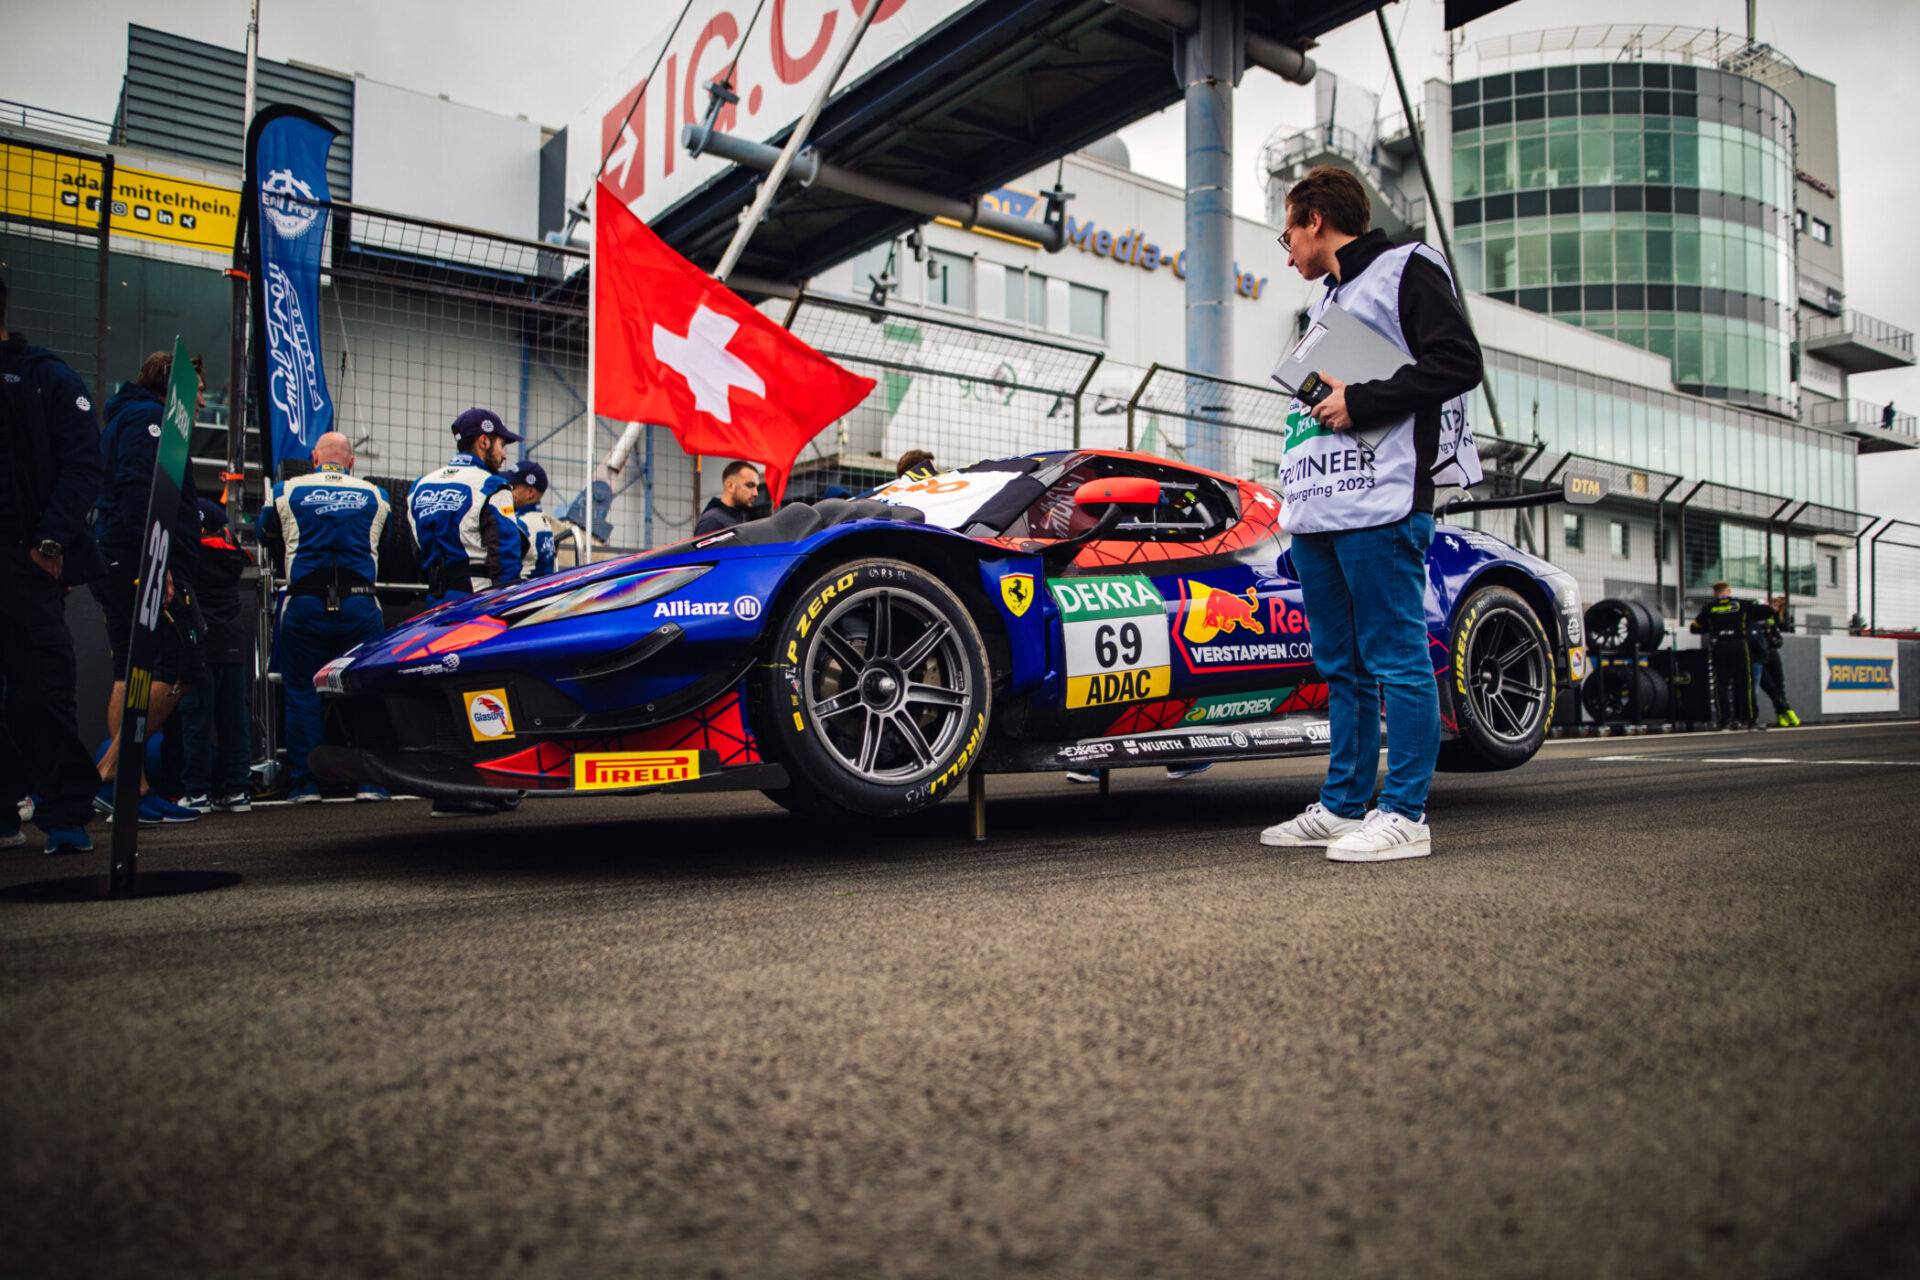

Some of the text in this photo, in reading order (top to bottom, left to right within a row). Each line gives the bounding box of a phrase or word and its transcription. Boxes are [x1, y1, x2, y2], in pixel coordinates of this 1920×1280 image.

[664, 0, 910, 179] IG.C
[1279, 449, 1376, 488] RUTINEER
[1336, 476, 1376, 493] 2023
[1571, 477, 1600, 497] DTM
[139, 519, 170, 632] 23
[653, 599, 731, 618] Allianz
[1053, 580, 1162, 613] DEKRA
[785, 572, 855, 664] P ZERO
[1095, 622, 1143, 669] 69
[1457, 608, 1476, 695] PIRELLI
[127, 666, 152, 710] DTM
[1086, 669, 1151, 705] ADAC
[1832, 664, 1889, 683] RAVENOL
[1206, 697, 1276, 720] MOTOREX
[930, 711, 985, 795] PIRELLI
[1138, 739, 1185, 753] WÜRTH
[1187, 735, 1233, 749] Allianz
[585, 756, 690, 784] PIRELLI
